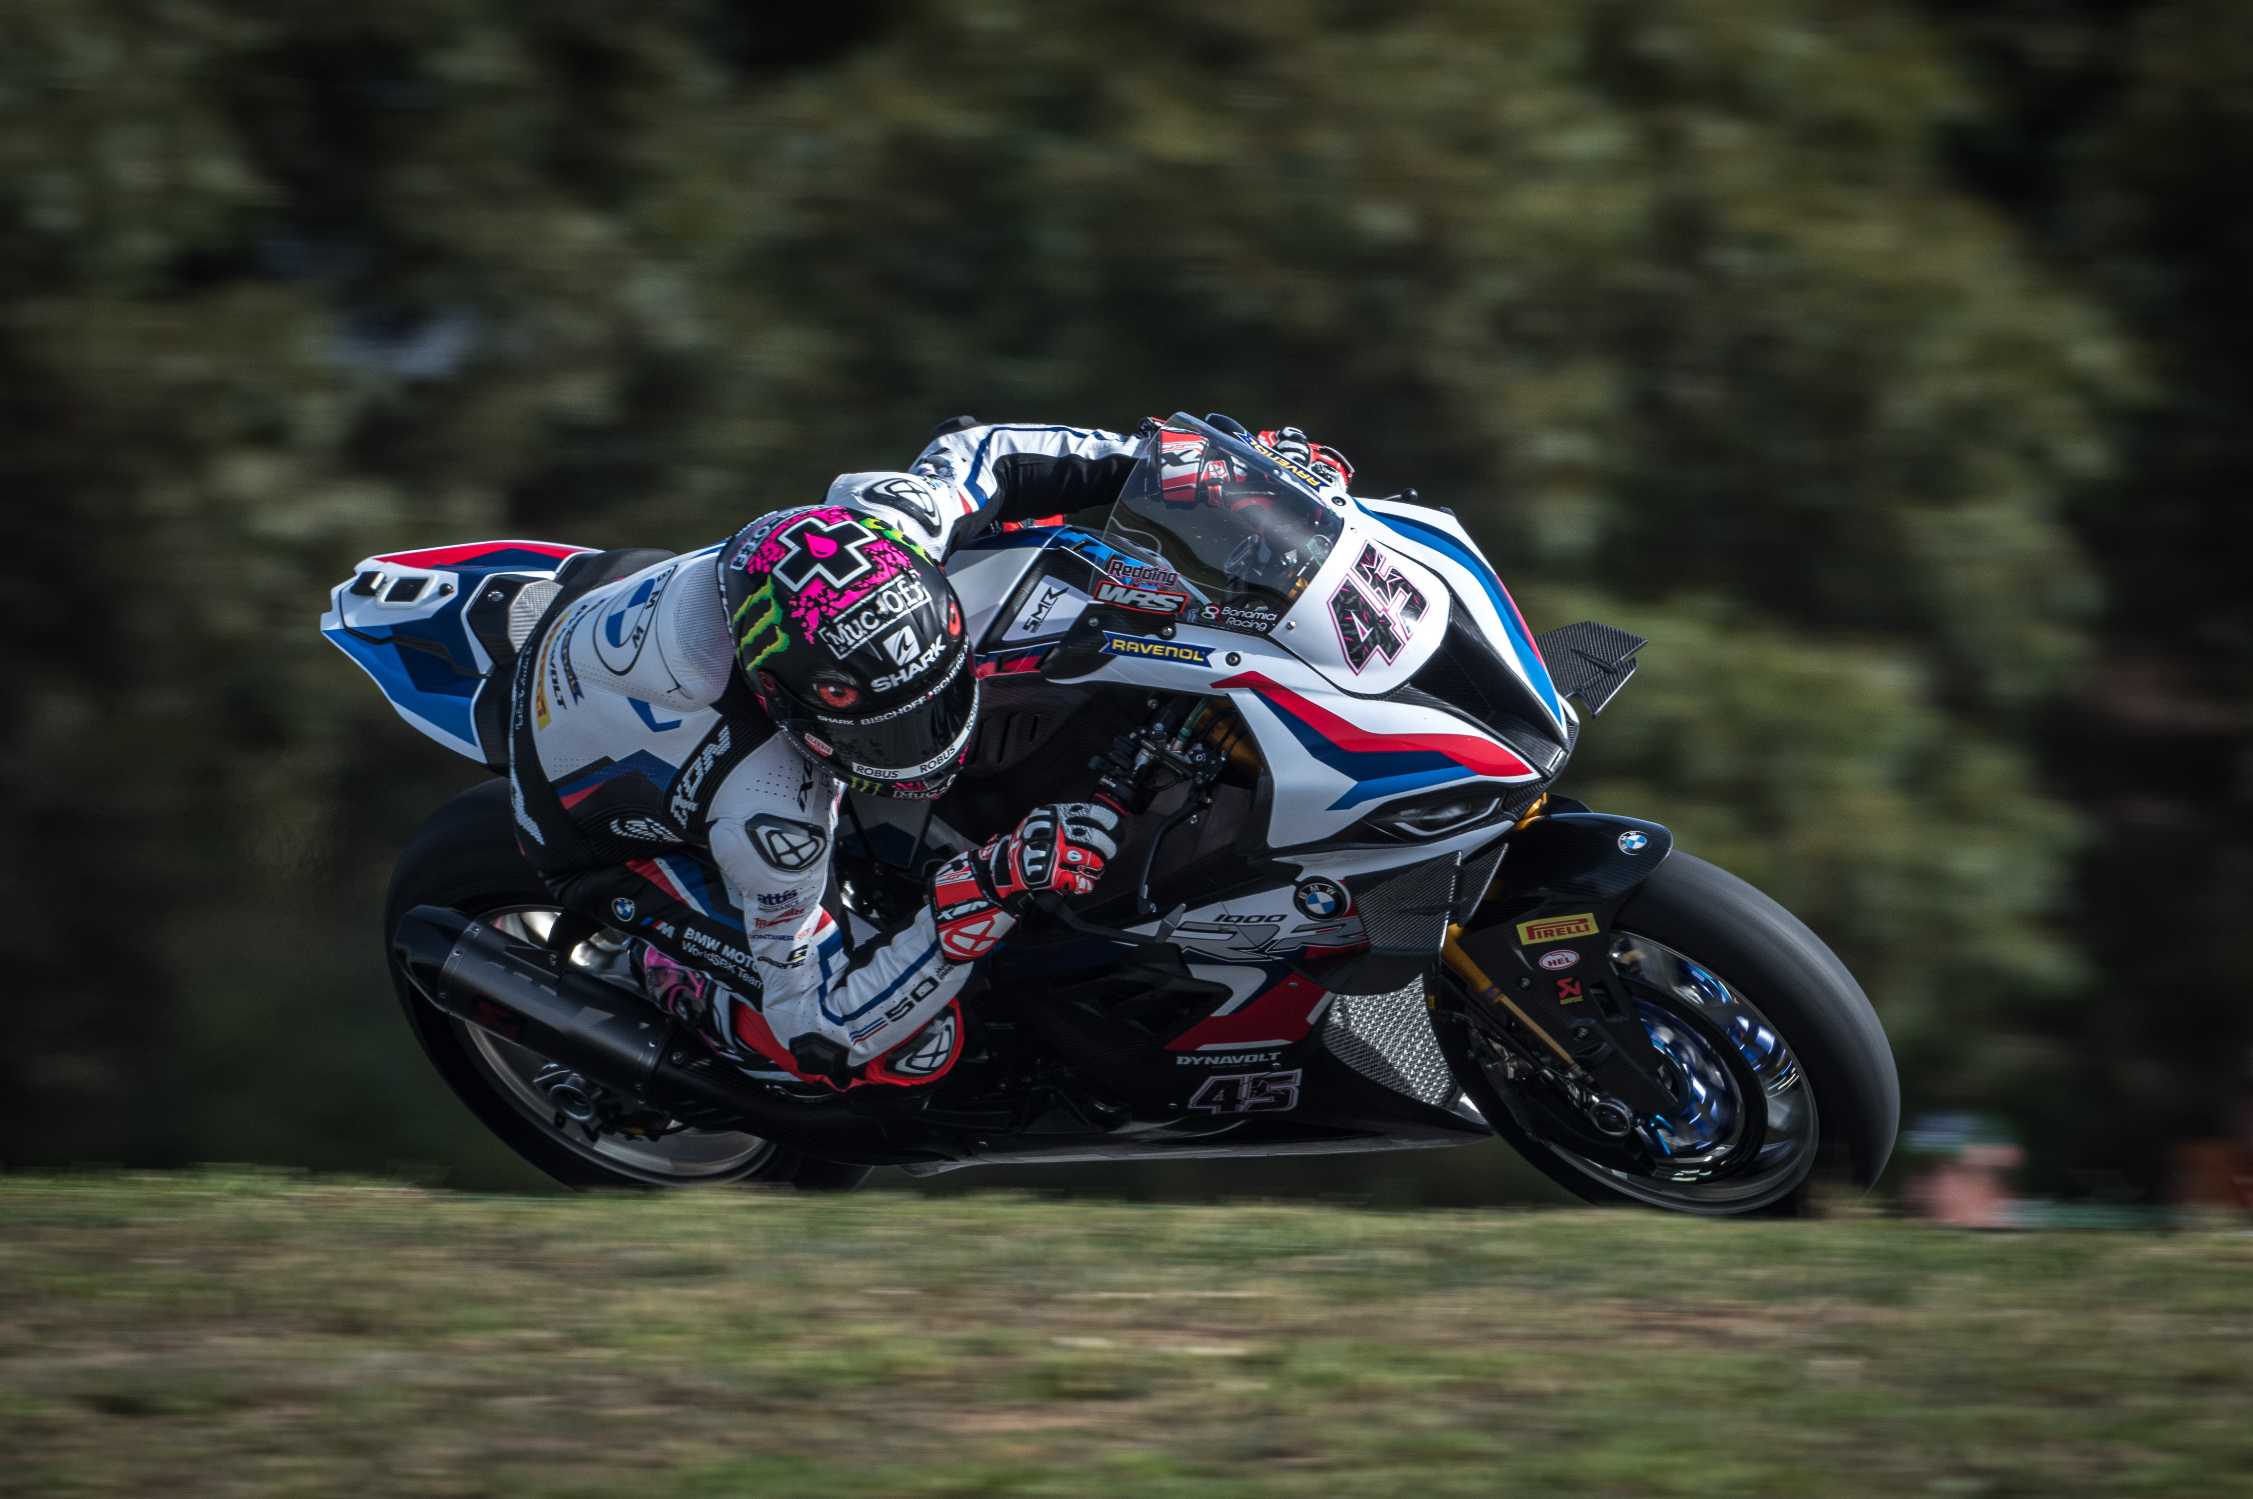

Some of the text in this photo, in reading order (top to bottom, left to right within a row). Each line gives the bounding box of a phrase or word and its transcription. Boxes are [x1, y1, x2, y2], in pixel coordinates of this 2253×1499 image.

[1248, 439, 1321, 487] RAVENOL
[1109, 559, 1178, 586] Redding
[1098, 584, 1183, 612] WRS
[1327, 539, 1431, 676] 45
[1226, 617, 1268, 631] Racing
[870, 634, 946, 692] SHARK
[1112, 638, 1205, 662] RAVENOL
[817, 715, 855, 726] SHARK
[856, 764, 899, 779] ROBUS
[919, 744, 956, 773] ROBUS
[1213, 913, 1288, 924] 1000
[1526, 918, 1591, 941] PIRELLI
[684, 927, 721, 953] BMW
[1547, 956, 1571, 967] HEL
[884, 975, 940, 1023] 50
[1176, 1051, 1282, 1066] DYNAVOLT
[1188, 1067, 1303, 1115] 45
